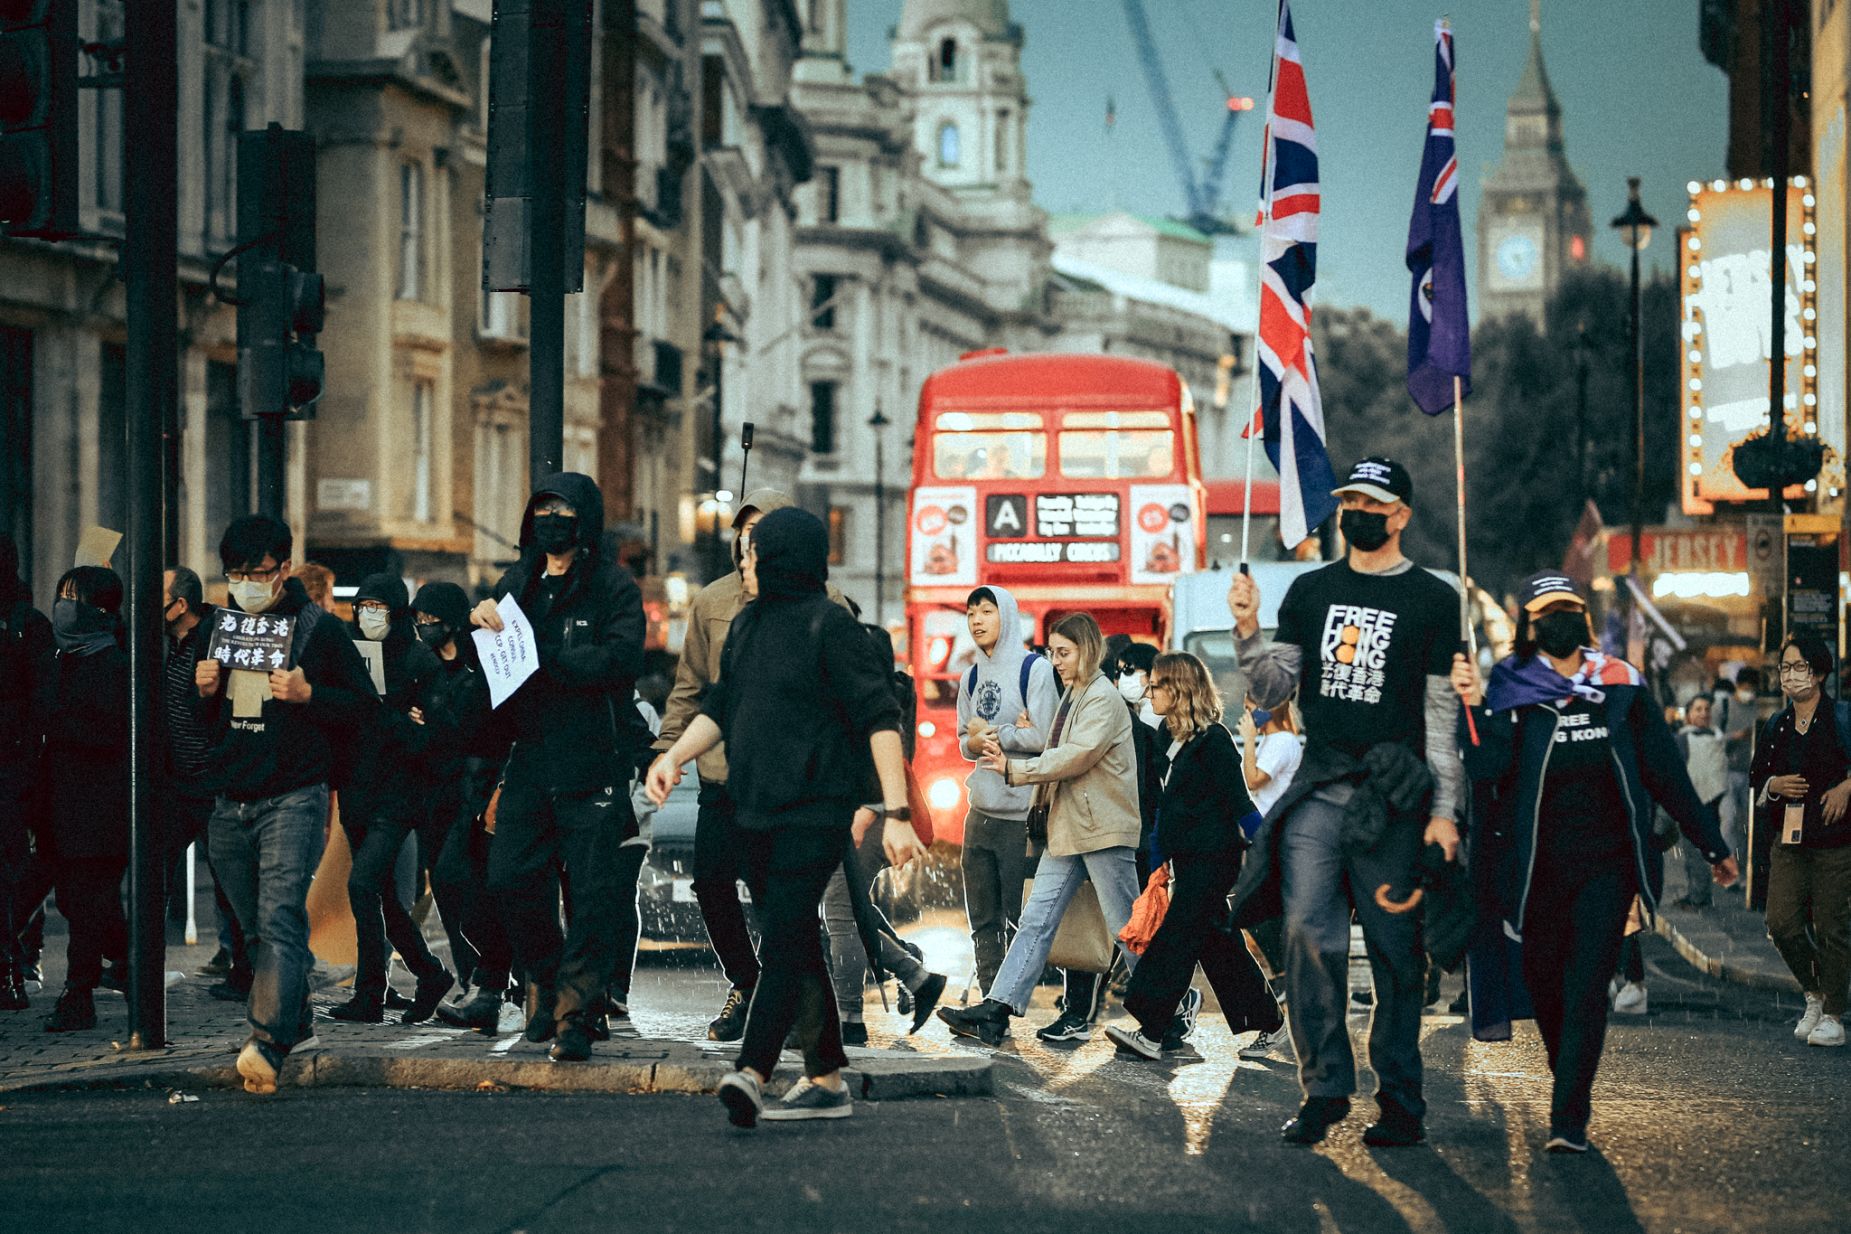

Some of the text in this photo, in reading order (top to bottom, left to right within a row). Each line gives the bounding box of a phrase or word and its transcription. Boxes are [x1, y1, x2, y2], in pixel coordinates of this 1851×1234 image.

[993, 500, 1020, 530] A
[1326, 604, 1398, 633] FREE
[1321, 642, 1387, 669] KONG
[1559, 713, 1591, 727] REE
[1571, 726, 1609, 742] KON
